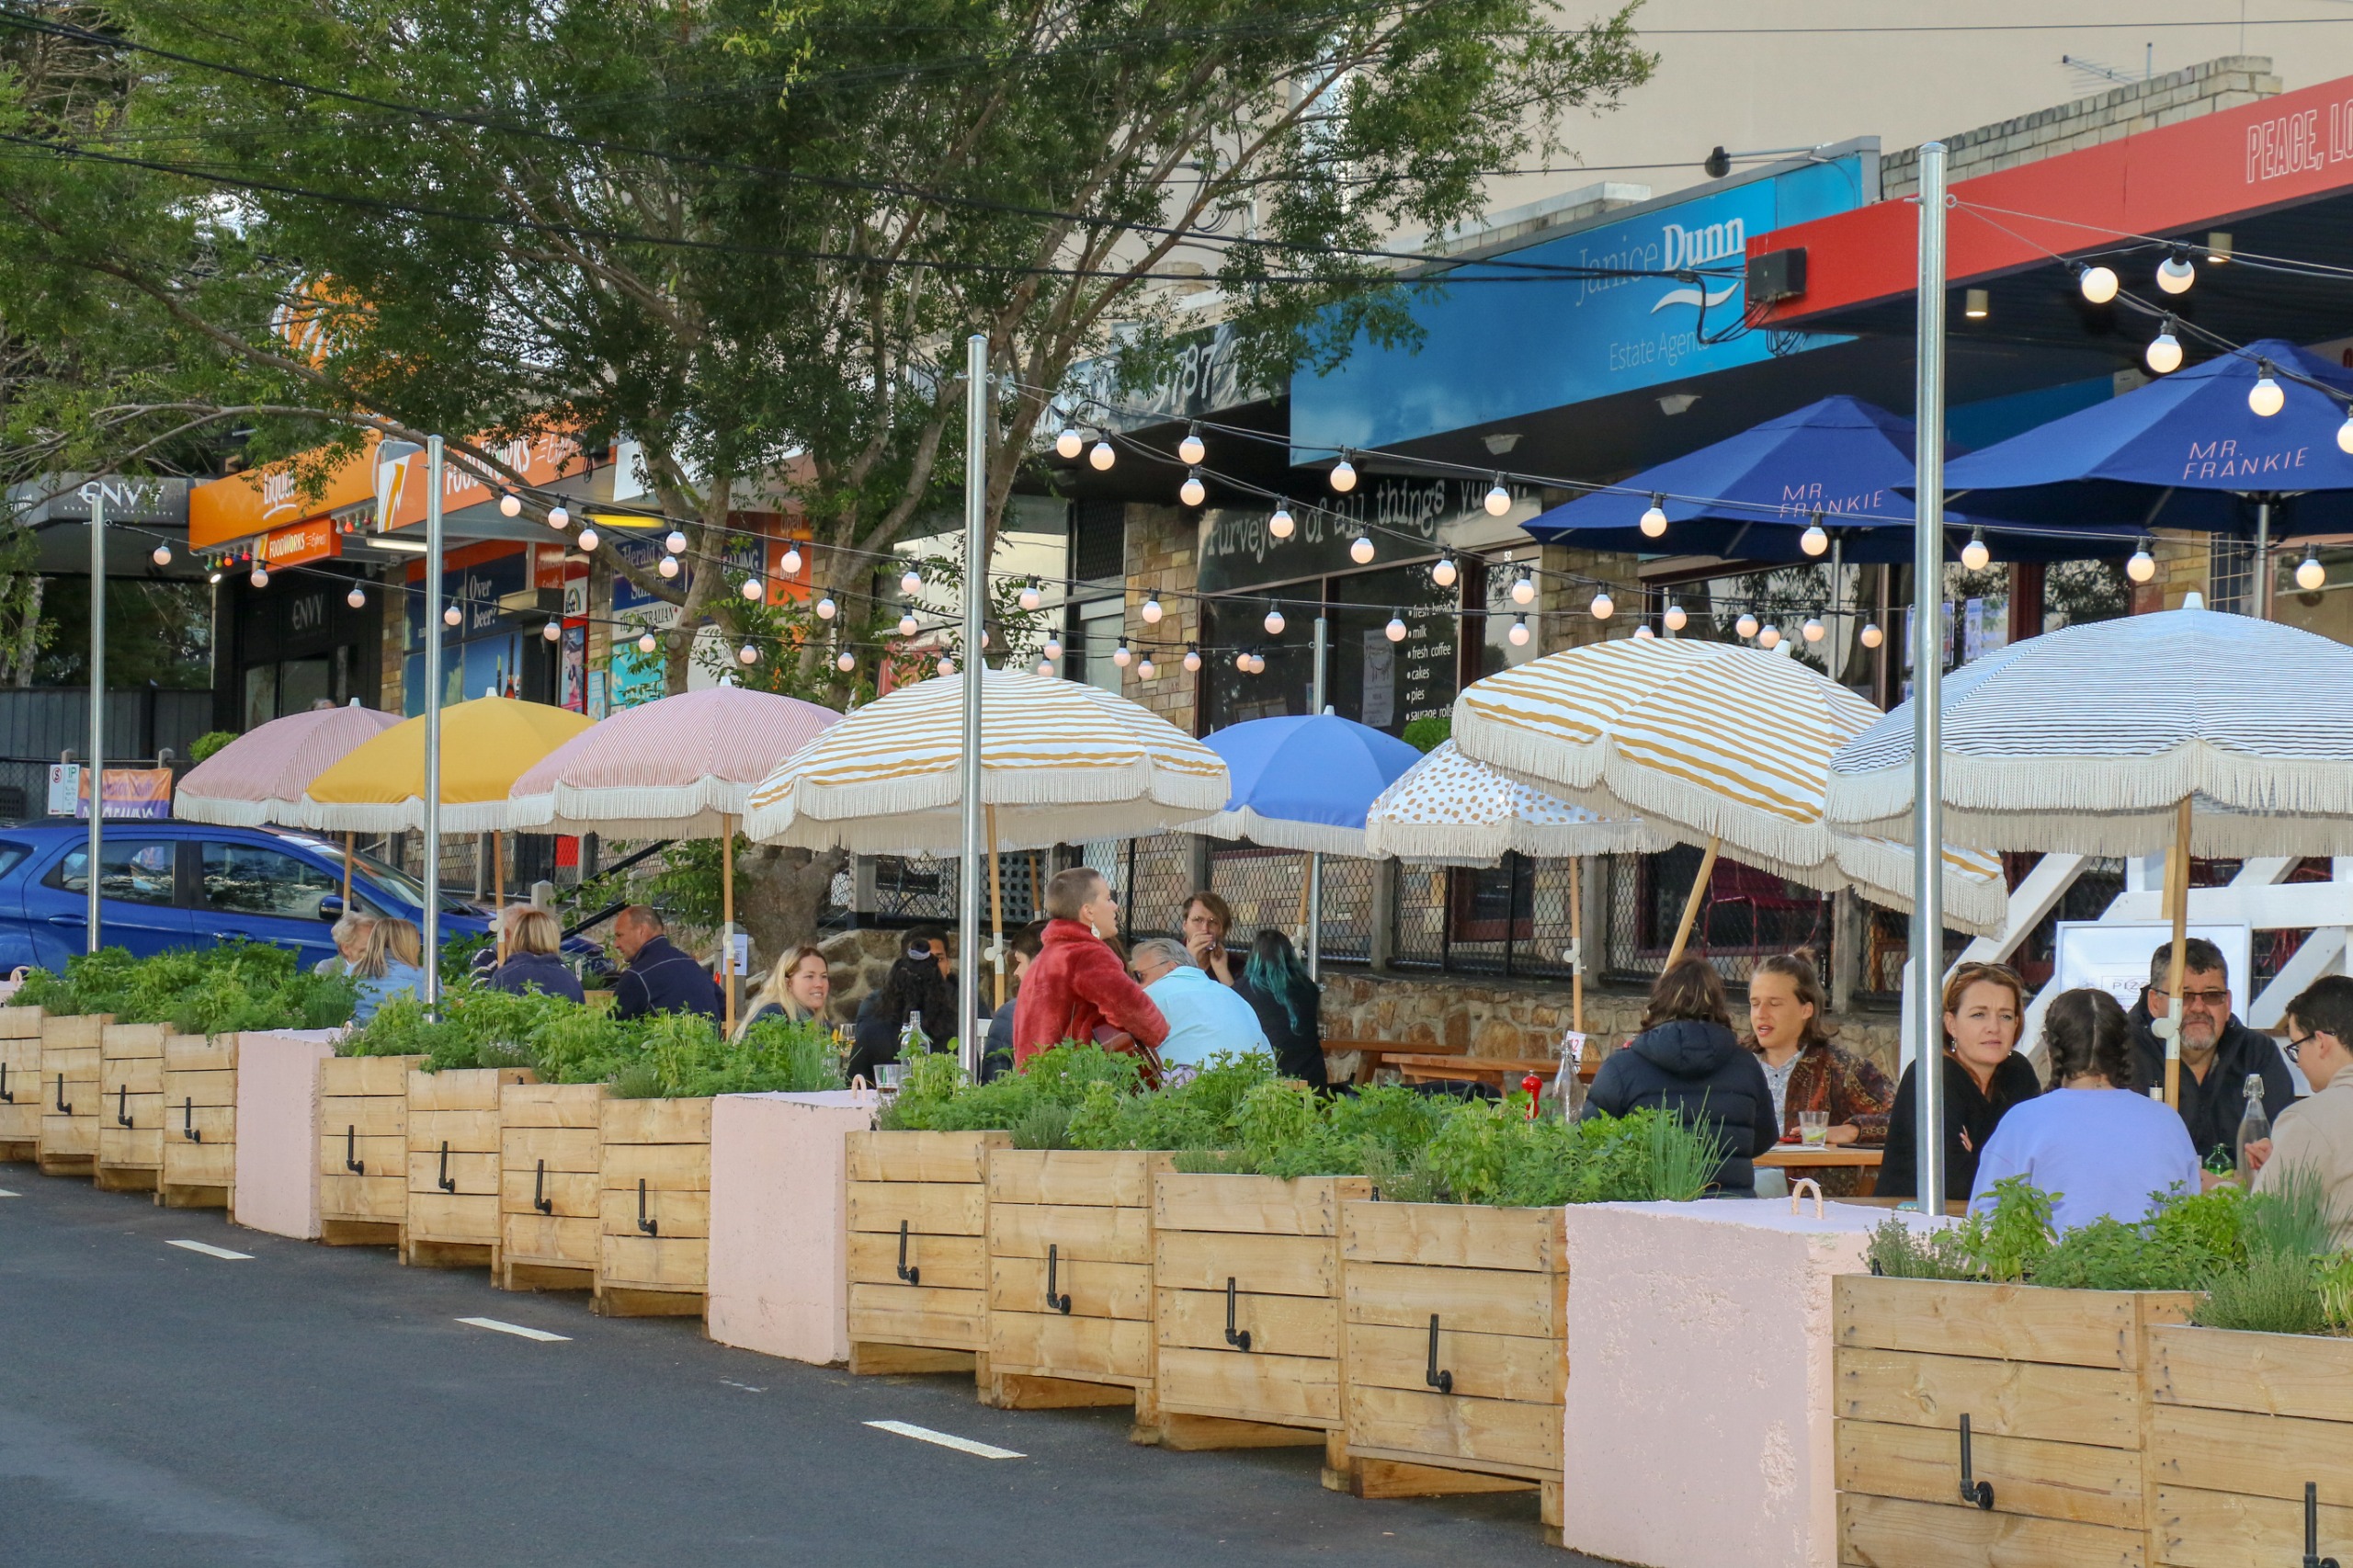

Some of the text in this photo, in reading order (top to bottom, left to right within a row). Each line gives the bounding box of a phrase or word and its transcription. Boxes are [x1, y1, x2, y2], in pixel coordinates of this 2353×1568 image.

[2247, 108, 2325, 183] PEACE,
[1575, 217, 1745, 307] Janice Dunn
[1609, 341, 1654, 372] Estate
[2189, 440, 2243, 460] MR.
[2183, 447, 2309, 481] FRANKIE
[1783, 483, 1828, 501] MR.
[1779, 490, 1883, 518] FRANKIE
[1207, 478, 1528, 563] Purveys of all things yuy.
[269, 532, 305, 559] FOODWORKS
[1504, 551, 1513, 562] 52
[470, 574, 492, 599] Over
[473, 598, 497, 629] beer?
[634, 606, 675, 629] TRALIAN
[1413, 603, 1429, 619] fresh
[1413, 624, 1427, 639] milk
[1412, 642, 1451, 660] fresh coffee
[1412, 666, 1430, 680] cakes
[1411, 687, 1425, 704] pies
[1410, 704, 1453, 722] sausage rolls
